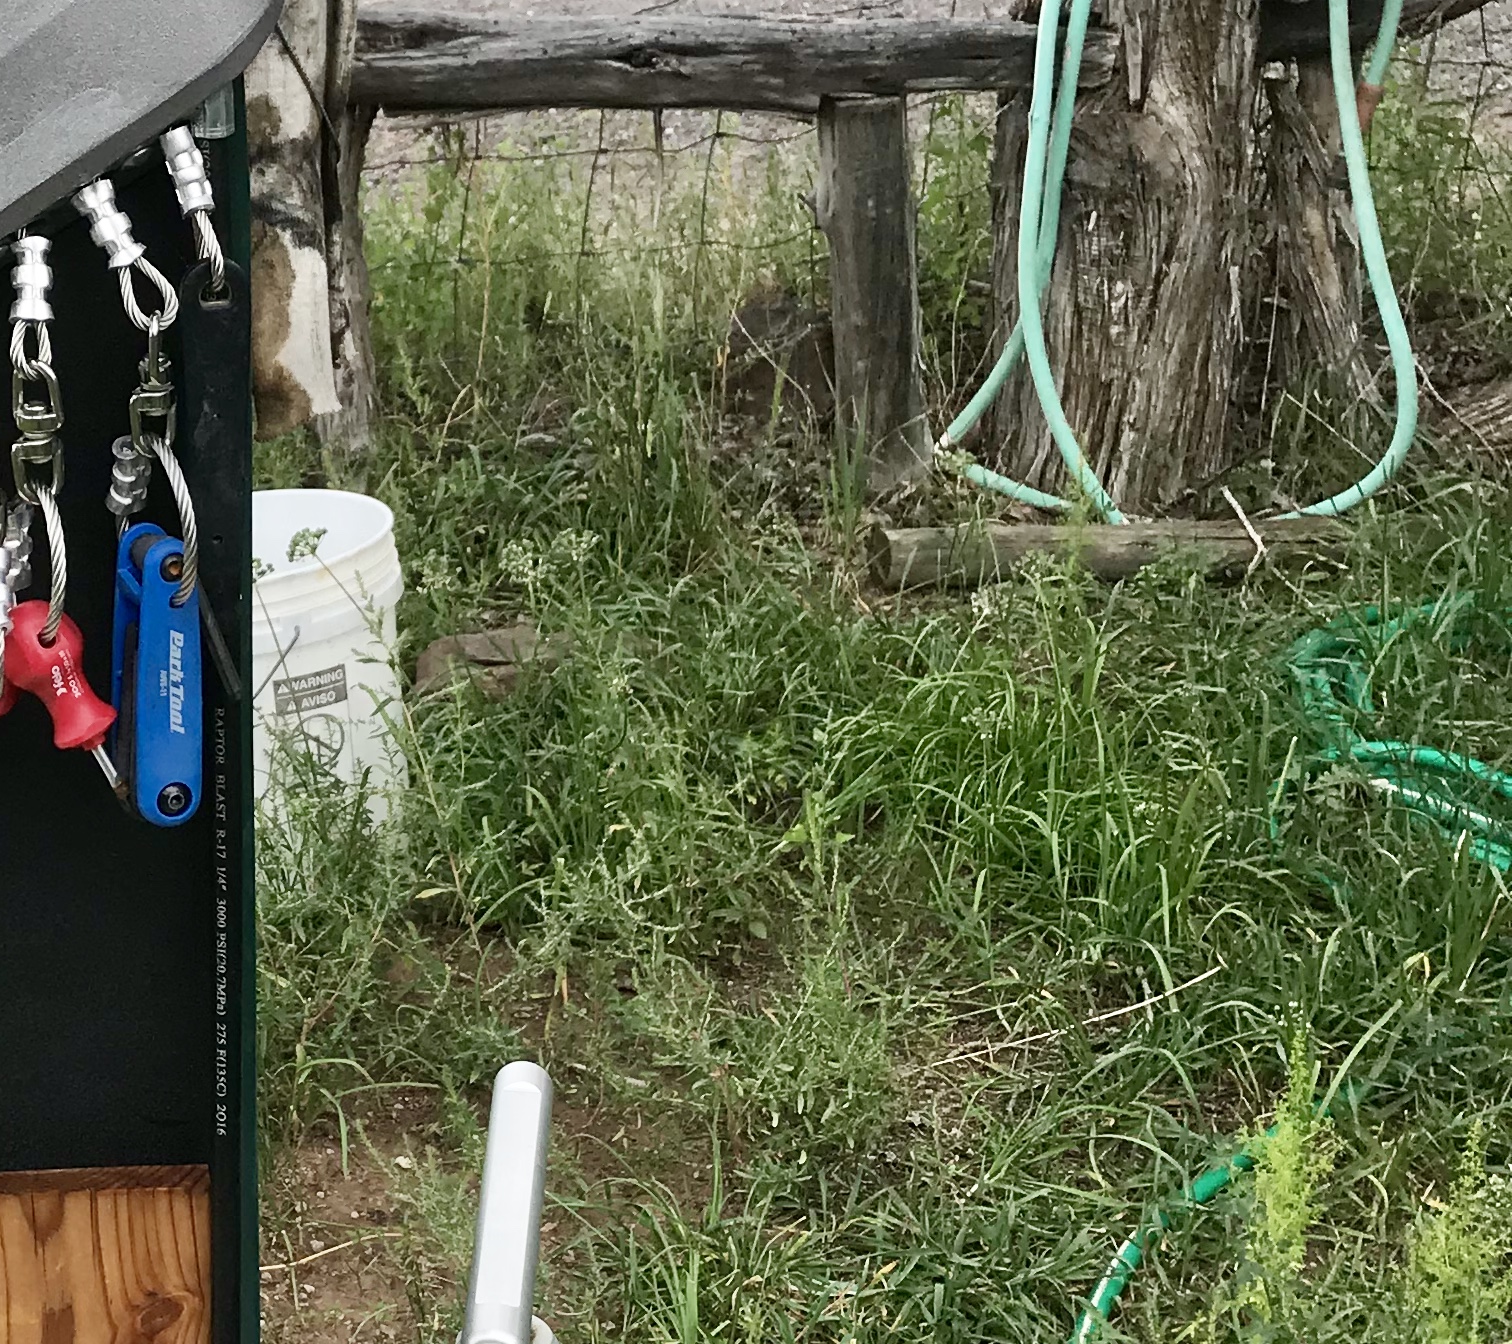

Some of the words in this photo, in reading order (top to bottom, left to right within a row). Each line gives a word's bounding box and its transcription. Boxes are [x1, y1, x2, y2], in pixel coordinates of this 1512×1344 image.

[290, 668, 343, 690] WARNING
[170, 684, 185, 734] Tool
[301, 691, 336, 709] AVISO
[216, 708, 226, 764] RAPTOR
[217, 775, 225, 820] BLAST
[217, 829, 226, 859] R-17
[217, 898, 226, 928] 3000
[217, 1023, 226, 1044] 275
[217, 1049, 226, 1097] F(135C)
